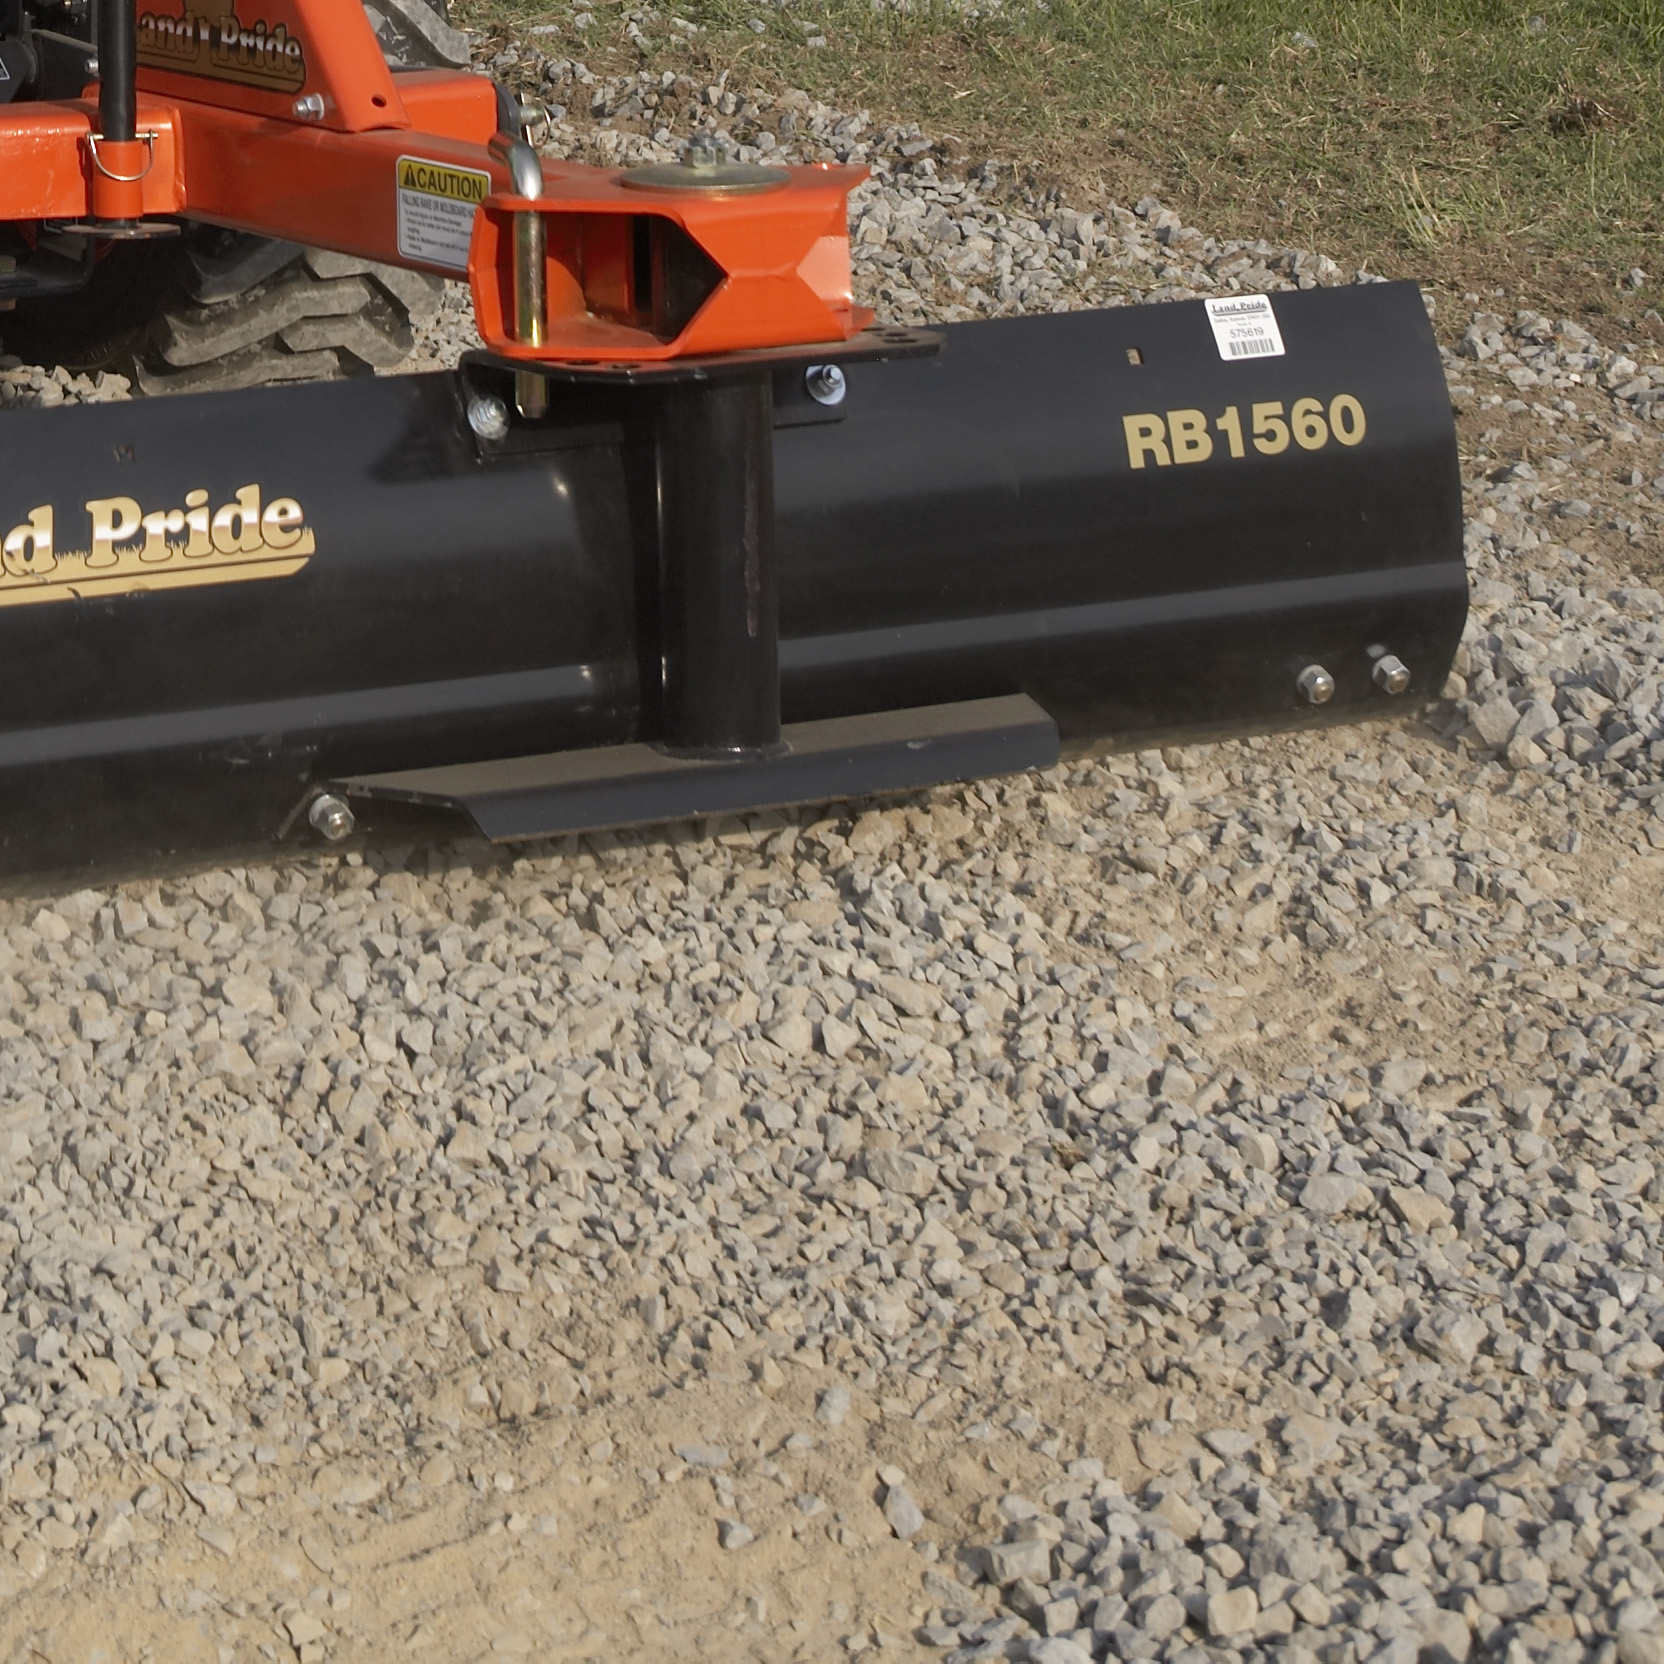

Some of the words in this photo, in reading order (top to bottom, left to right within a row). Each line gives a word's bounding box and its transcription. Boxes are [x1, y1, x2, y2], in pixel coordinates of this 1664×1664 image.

[138, 9, 196, 56] and
[217, 16, 301, 74] Pride
[417, 167, 483, 200] CAUTION
[1212, 302, 1239, 313] Land
[1240, 301, 1267, 311] Pride
[1122, 393, 1367, 469] RB1560
[85, 483, 304, 568] Pride
